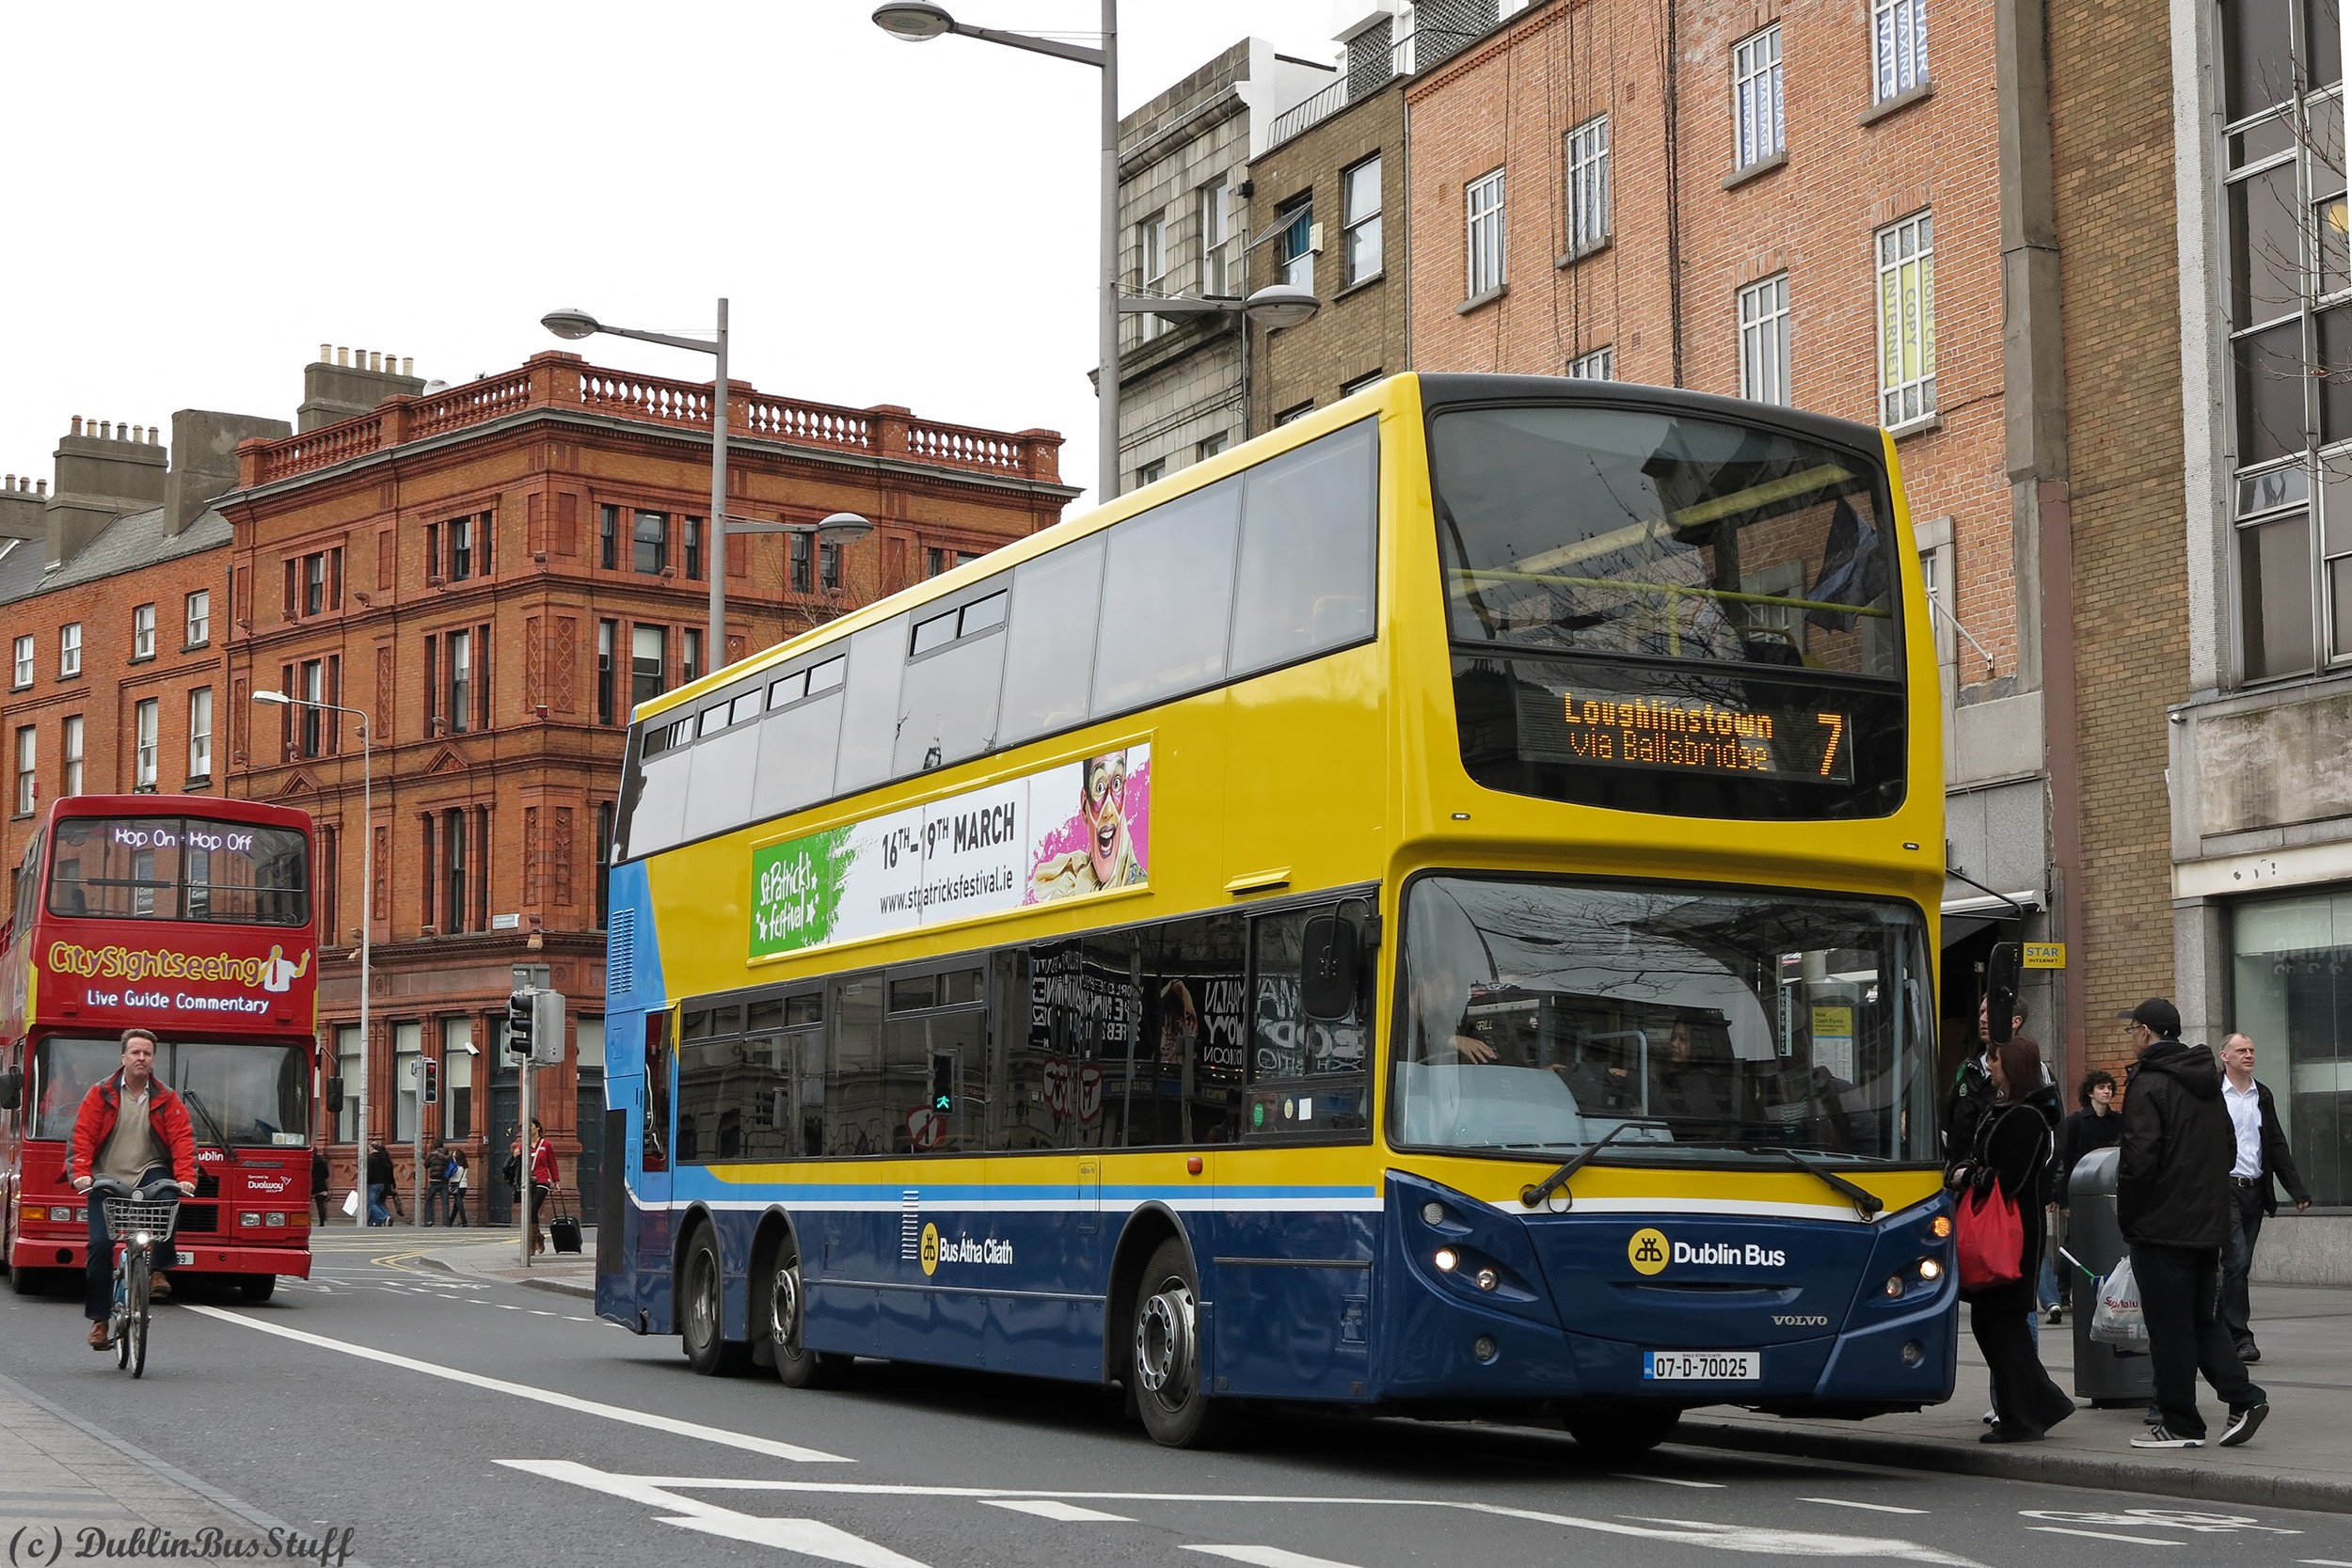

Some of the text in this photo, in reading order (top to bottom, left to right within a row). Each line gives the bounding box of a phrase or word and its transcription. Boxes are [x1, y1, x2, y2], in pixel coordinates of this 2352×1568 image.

[1879, 16, 1893, 99] NAILS
[1899, 3, 1910, 87] WAXING
[1915, 2, 1928, 75] HAIR
[1759, 76, 1769, 156] MASSAGE
[1775, 70, 1786, 149] FACIALS
[1924, 257, 1934, 323] PHONE
[1886, 276, 1899, 376] INTERNET
[1905, 288, 1916, 346] COPY
[1565, 692, 1843, 775] Loughlinstown 7
[1570, 727, 1769, 770] via Ballsbridge
[115, 829, 148, 847] Hop
[153, 829, 176, 847] On
[189, 832, 222, 851] Hop
[227, 833, 253, 850] Off
[953, 801, 1015, 854] MARCH
[880, 864, 1013, 915] www.stpatricksfestival.ie
[49, 941, 262, 988] CitySightseeing
[2026, 946, 2058, 957] STAR
[88, 990, 269, 1014] Live Guide Commentary
[198, 1150, 224, 1162] ublin
[247, 1180, 284, 1192] Dualway
[939, 1231, 1013, 1265] Bus Átha Cliath
[1674, 1241, 1786, 1267] Dublin Bus
[1771, 1315, 1829, 1326] VOLVO
[1656, 1357, 1747, 1377] 07-D-70025
